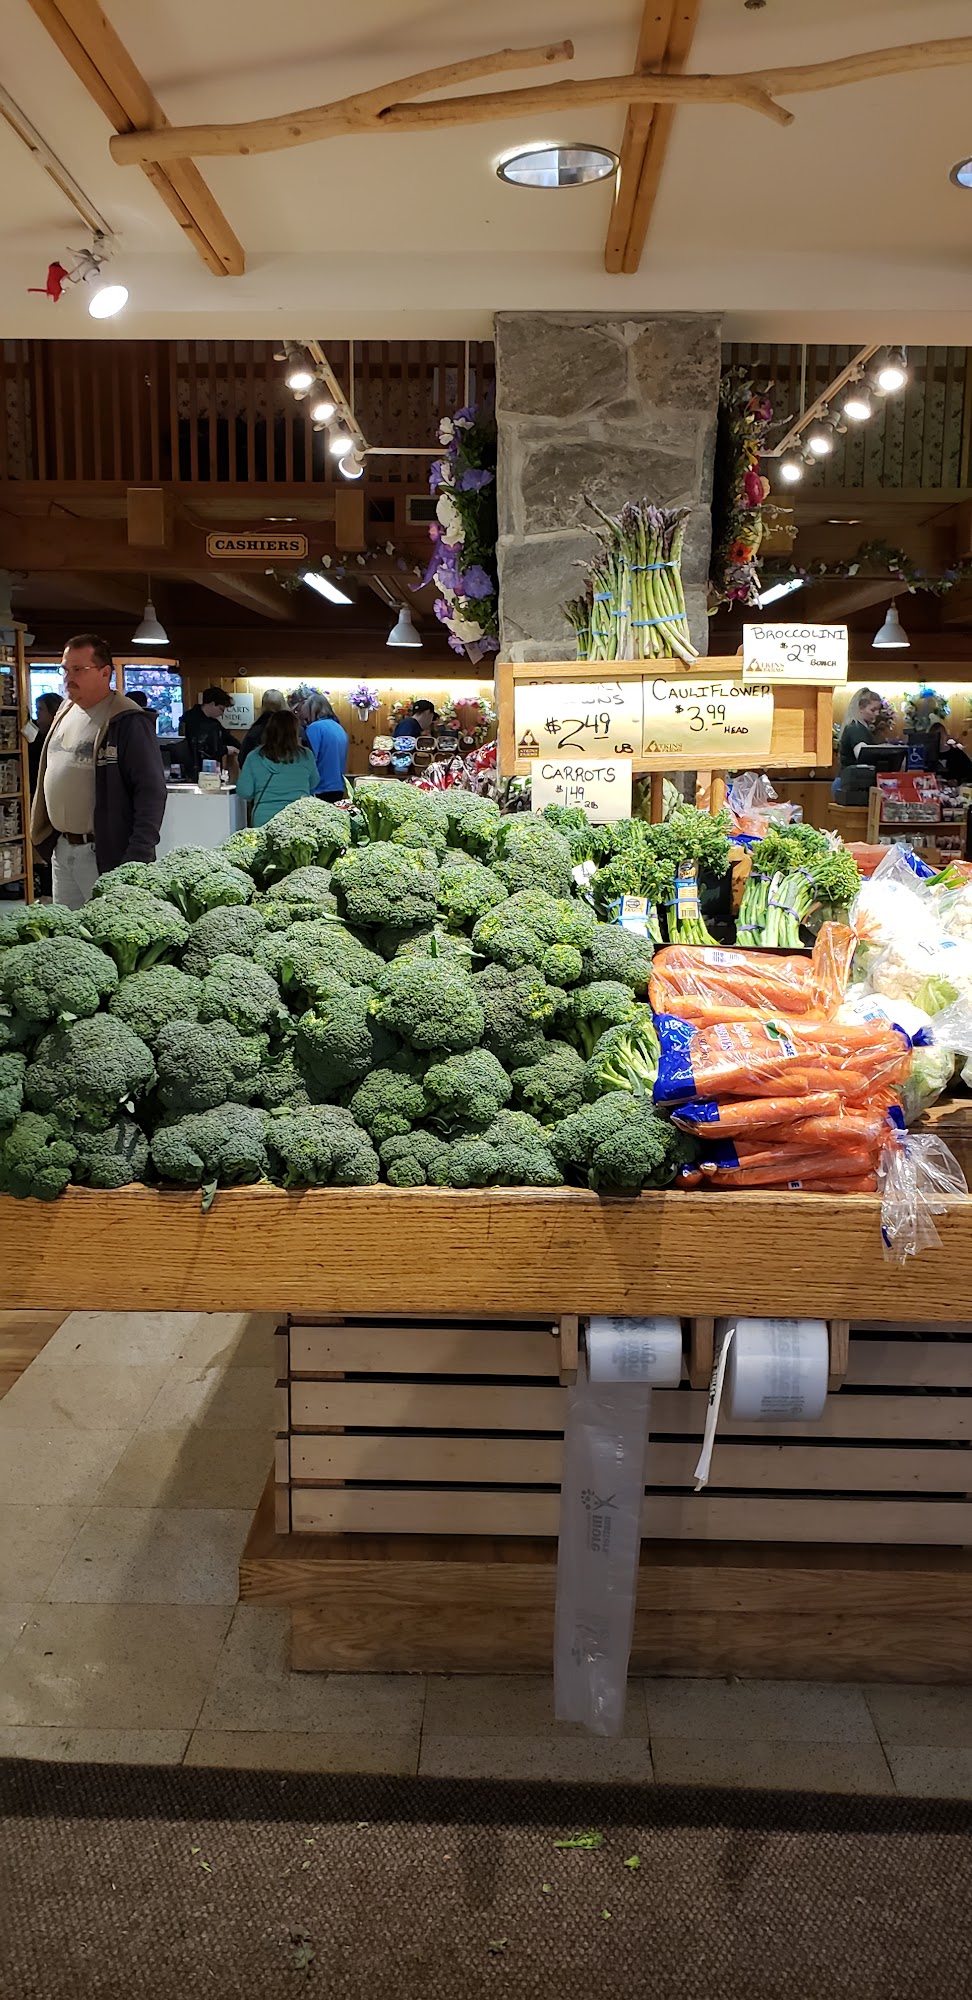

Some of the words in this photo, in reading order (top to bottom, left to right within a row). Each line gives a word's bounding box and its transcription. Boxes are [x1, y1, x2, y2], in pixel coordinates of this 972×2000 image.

[215, 540, 300, 551] CASHIERS
[750, 627, 846, 640] BROCCOLINI
[724, 726, 749, 734] HEAD
[541, 764, 616, 783] CARROTS
